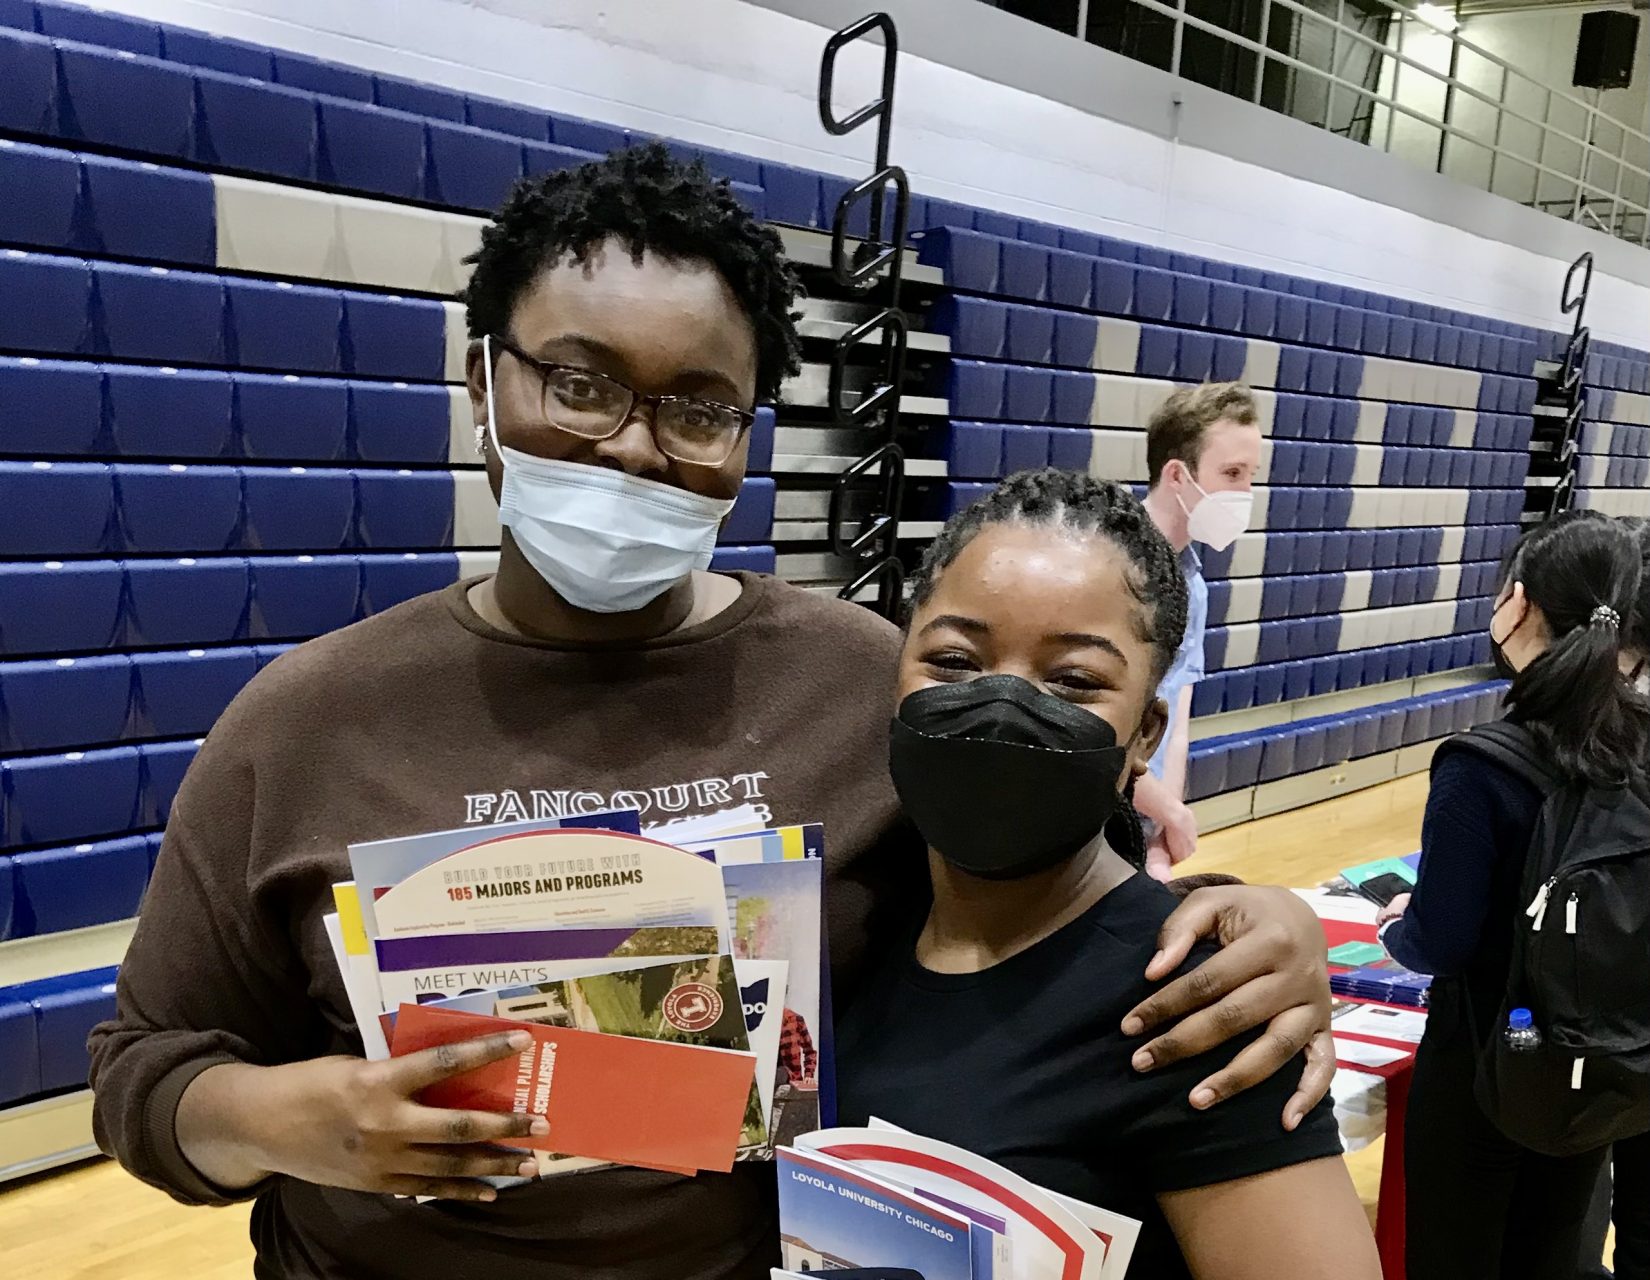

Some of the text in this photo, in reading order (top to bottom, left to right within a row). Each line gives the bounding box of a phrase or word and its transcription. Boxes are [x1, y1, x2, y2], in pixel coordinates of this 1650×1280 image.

[464, 771, 770, 823] FANCOURT
[443, 853, 641, 884] BUILD YOUR FUTURE WITH
[447, 886, 473, 901] 185
[476, 881, 531, 899] MAJORS
[535, 877, 563, 894] AND
[566, 869, 643, 891] PROGRAMS
[414, 967, 548, 991] MEET WHAT'S
[533, 1041, 558, 1114] SCHOLARSHIPS
[792, 1170, 954, 1243] LOYOLA UNIVERSITY CHICAGO
